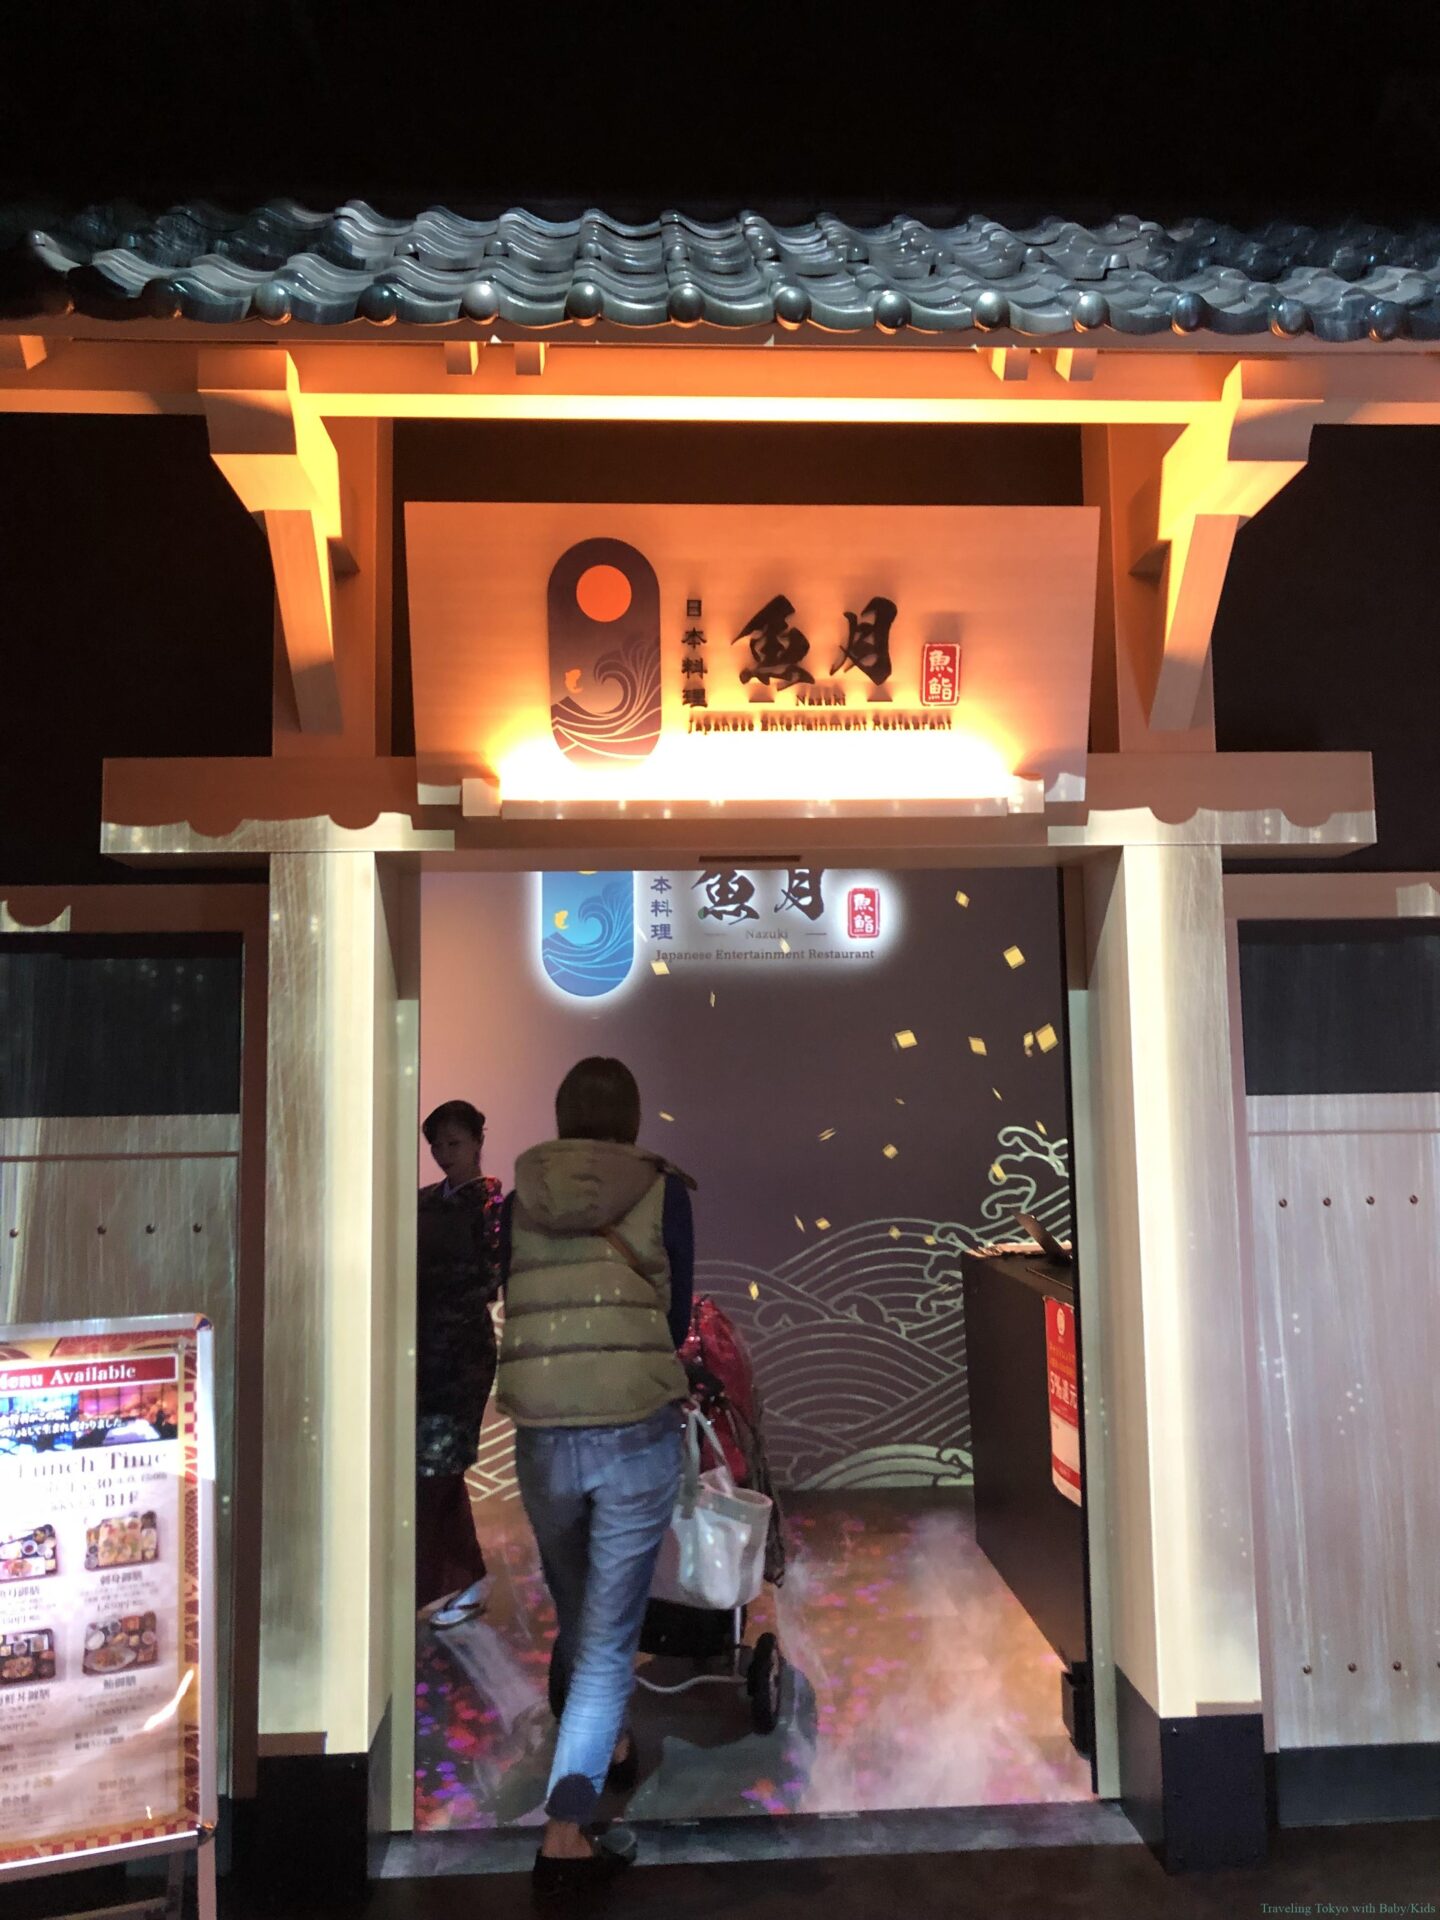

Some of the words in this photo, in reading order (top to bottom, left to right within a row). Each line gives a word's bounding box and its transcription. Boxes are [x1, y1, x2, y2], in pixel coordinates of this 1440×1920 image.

[682, 598, 708, 708] 日本料理
[796, 693, 846, 707] Nazuki
[688, 715, 755, 735] Japanese
[760, 715, 867, 732] Entertainment
[872, 715, 952, 732] Restaurant
[746, 928, 789, 940] Nazuki
[656, 949, 712, 962] Japanese
[716, 949, 805, 961] Entertainment
[808, 949, 875, 960] Restaurant
[50, 1365, 136, 1386] Available
